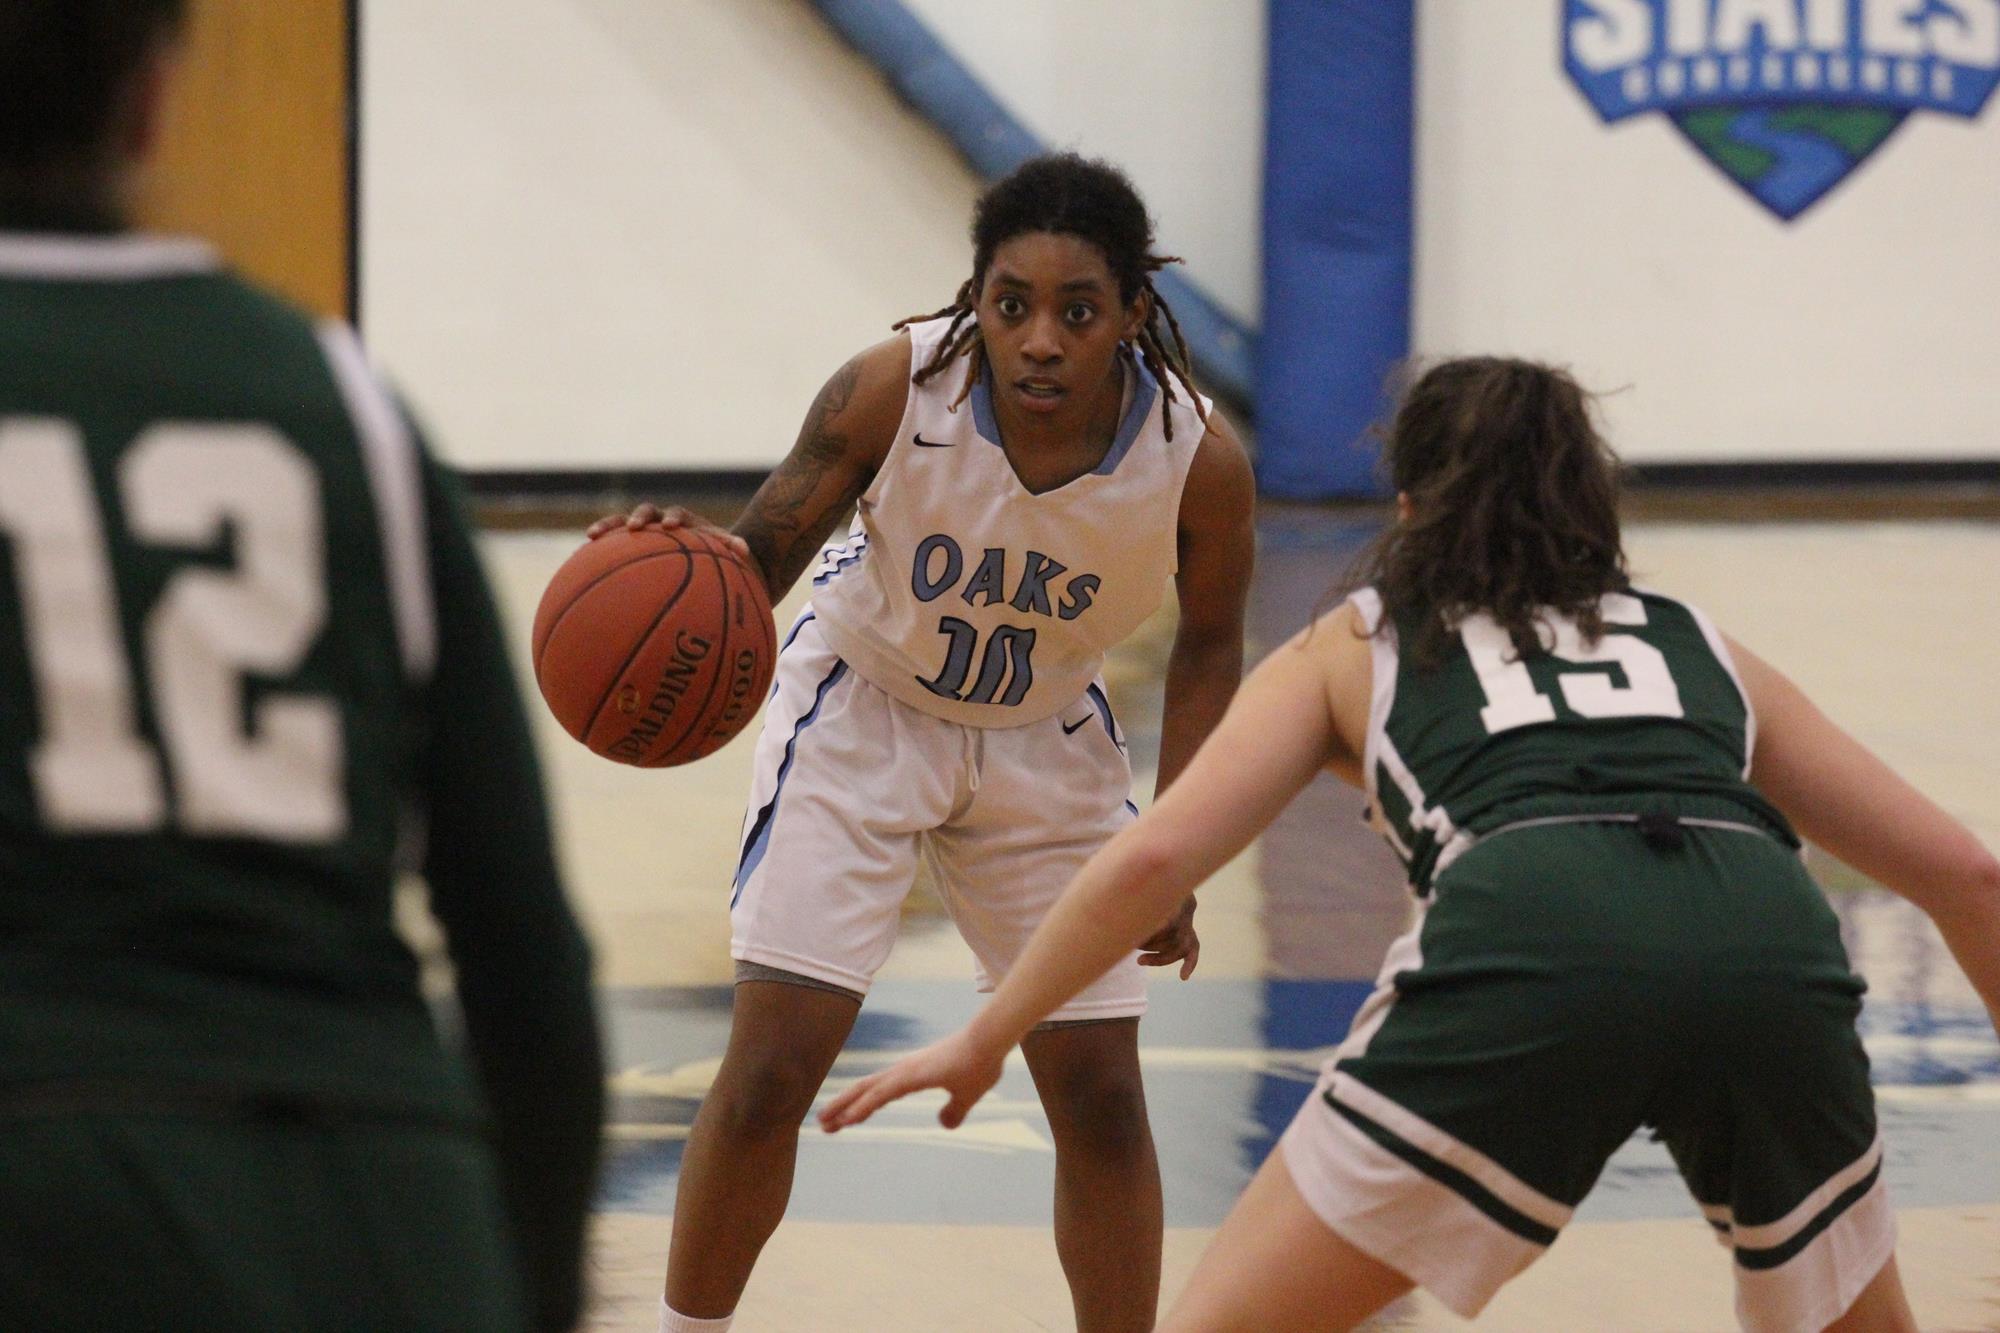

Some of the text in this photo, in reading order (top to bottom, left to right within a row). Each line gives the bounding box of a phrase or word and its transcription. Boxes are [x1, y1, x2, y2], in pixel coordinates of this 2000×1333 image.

[0, 414, 352, 846] 12
[911, 533, 1102, 621] OAKS
[914, 615, 1037, 707] 10
[1440, 591, 1685, 735] 15
